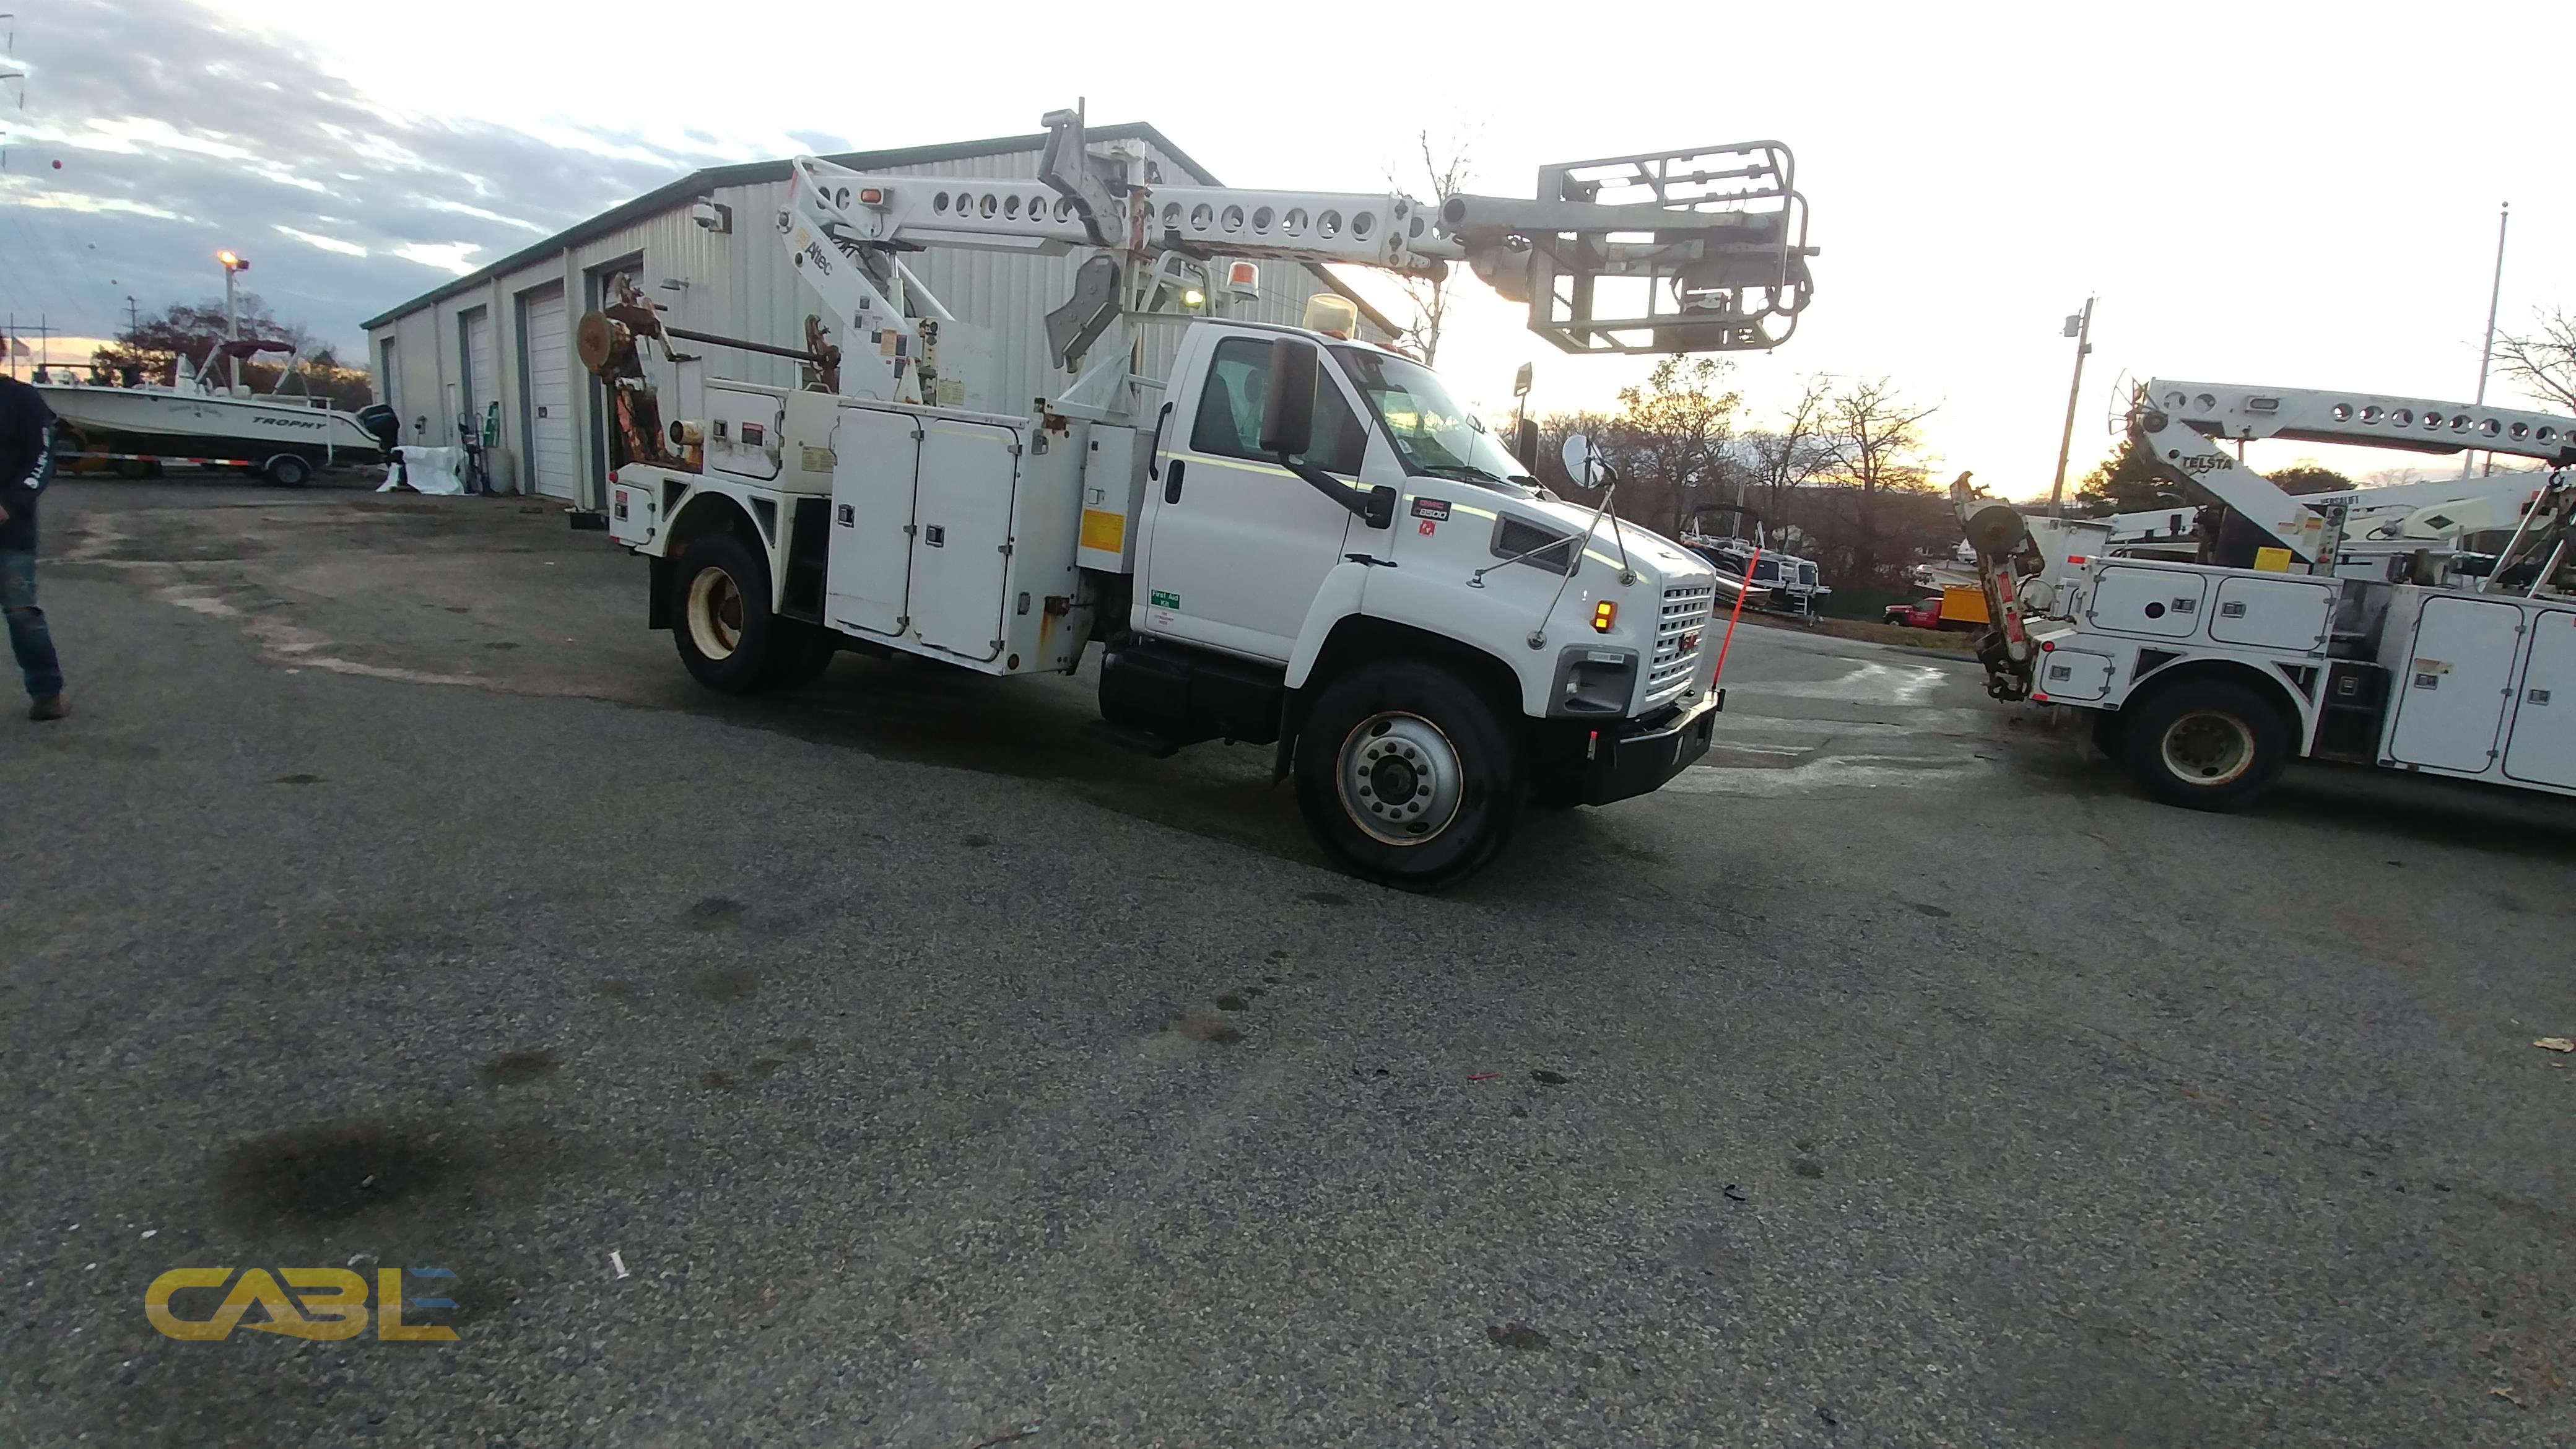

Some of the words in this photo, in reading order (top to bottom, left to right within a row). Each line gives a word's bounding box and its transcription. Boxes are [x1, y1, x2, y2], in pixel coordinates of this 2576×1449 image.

[804, 241, 832, 276] Altec
[253, 416, 327, 430] TROPHY
[2182, 456, 2233, 470] TELSTA
[1412, 507, 1447, 519] C8500
[1152, 590, 1166, 599] First
